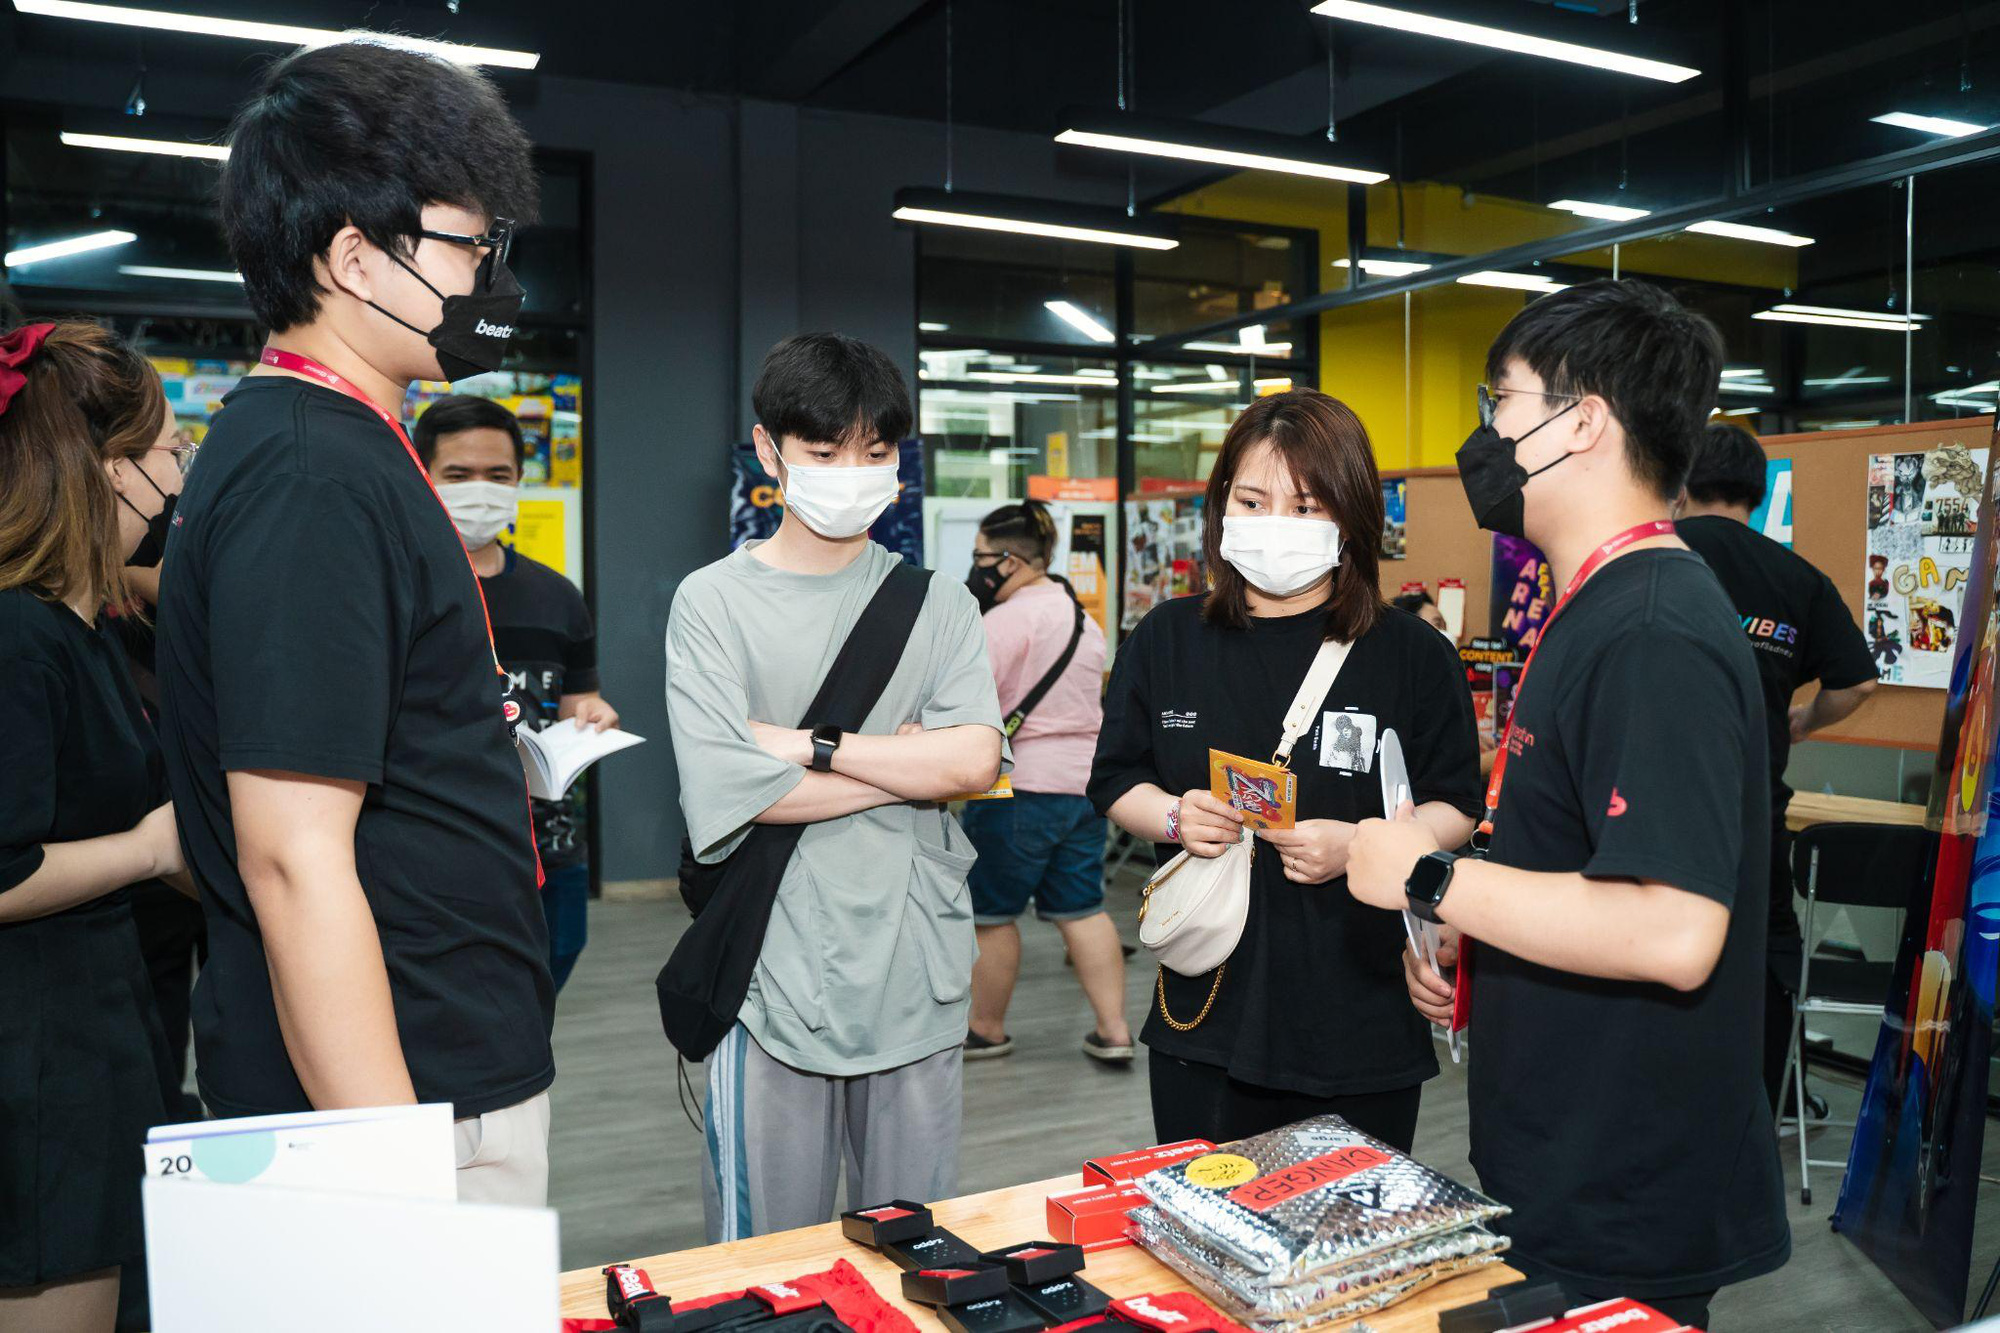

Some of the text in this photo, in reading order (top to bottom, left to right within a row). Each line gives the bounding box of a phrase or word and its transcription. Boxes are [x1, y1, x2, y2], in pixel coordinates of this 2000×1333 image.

[1892, 556, 1971, 596] GAM
[1459, 648, 1514, 662] CONTENT
[1310, 1134, 1351, 1145] Large
[1153, 1142, 1210, 1159] beatz
